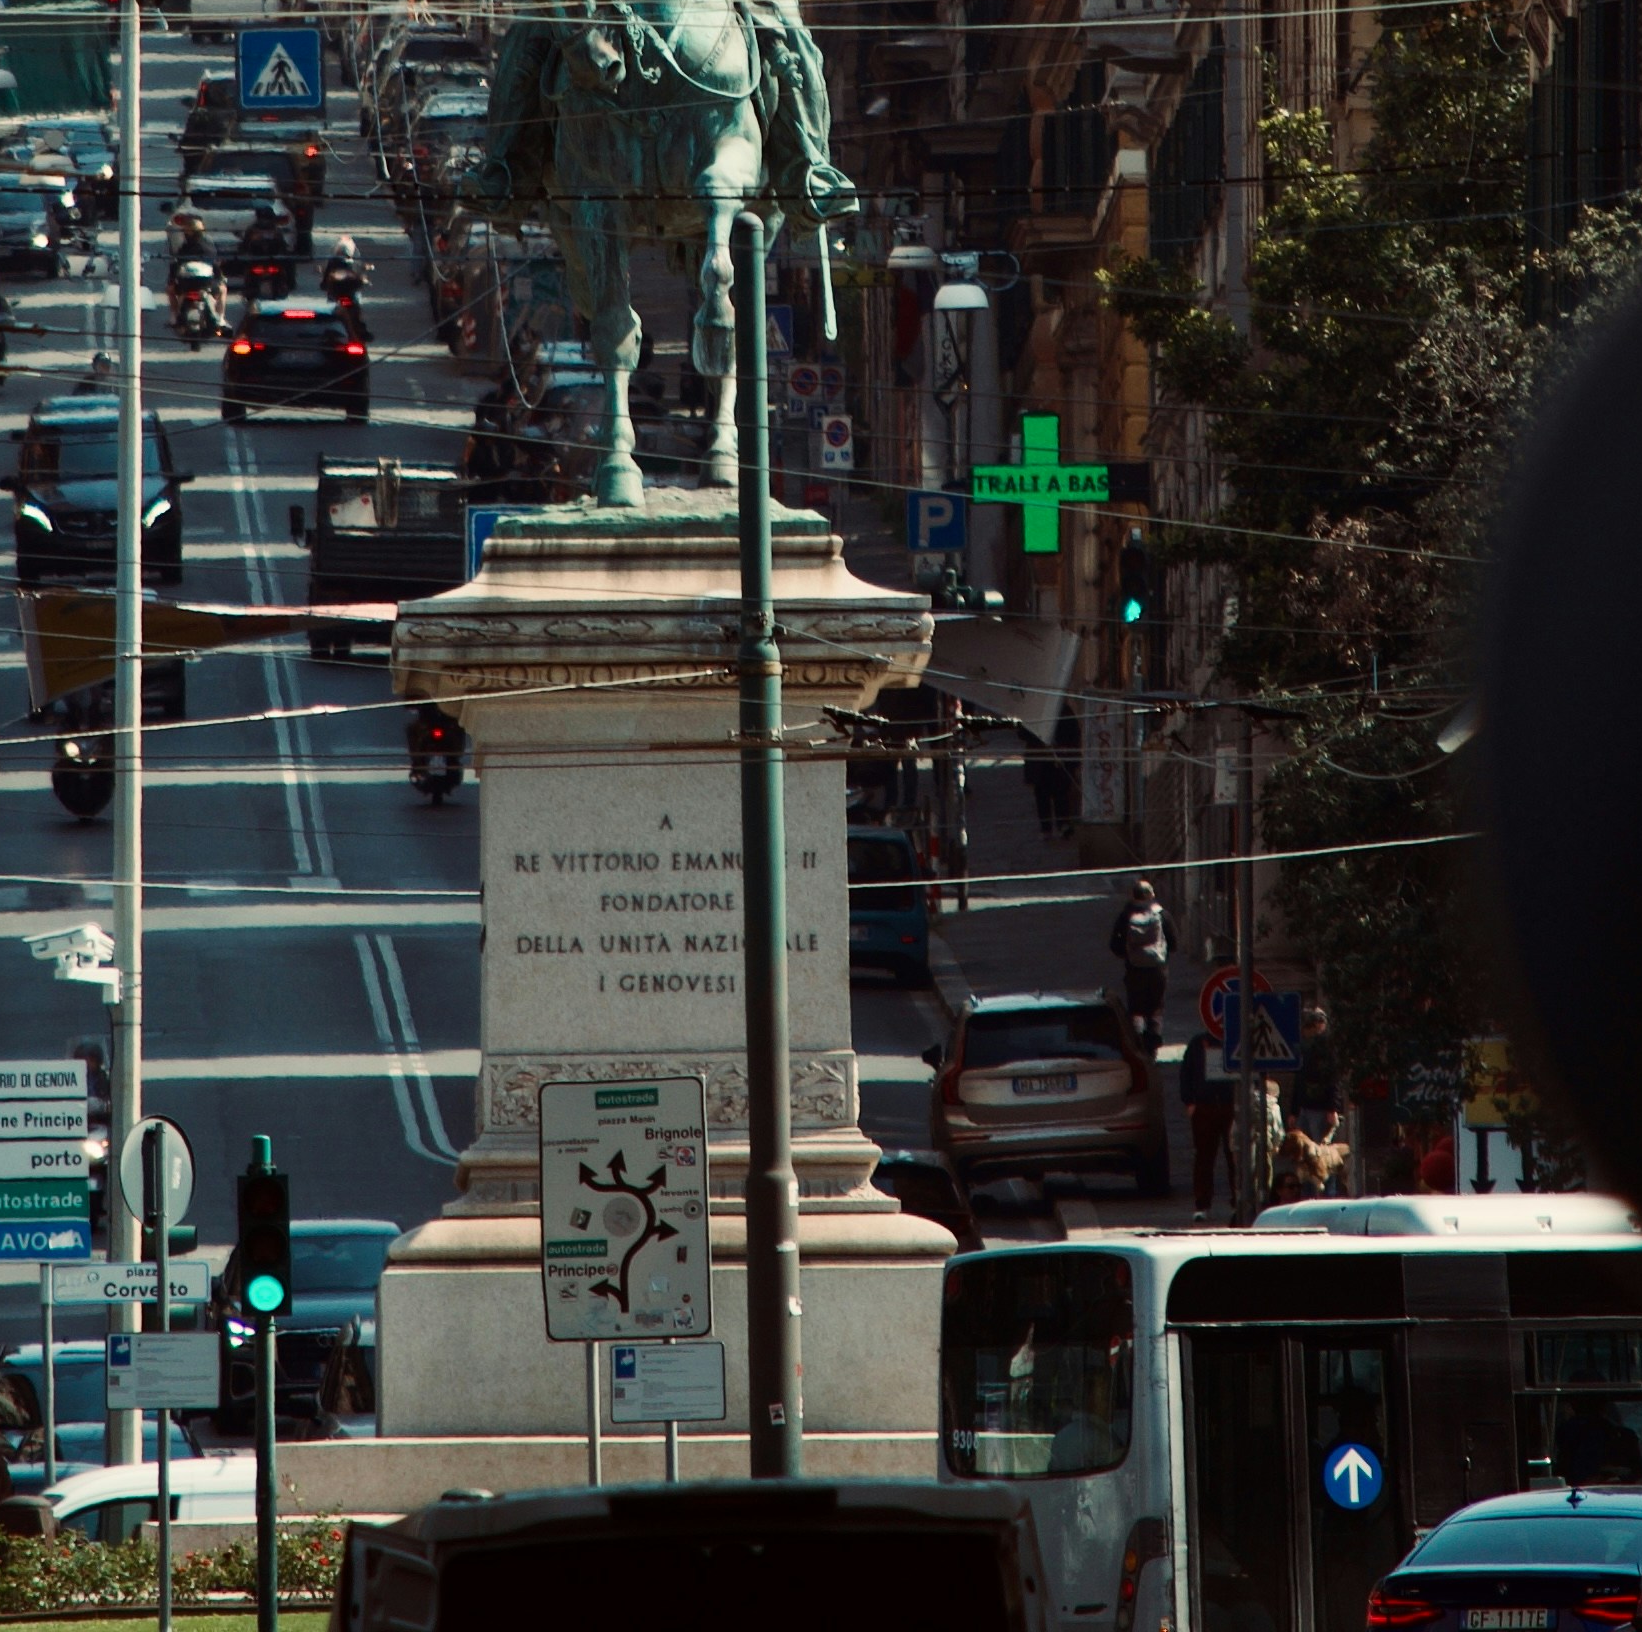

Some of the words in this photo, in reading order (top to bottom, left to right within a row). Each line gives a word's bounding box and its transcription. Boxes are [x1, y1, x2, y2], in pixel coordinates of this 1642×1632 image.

[974, 474, 1039, 494] TRALI
[1046, 475, 1061, 493] A
[659, 814, 673, 830] A
[515, 853, 540, 873] RE
[551, 852, 659, 872] VITTORIO
[803, 851, 817, 869] II
[601, 893, 735, 912] FONDATORE
[517, 935, 583, 954] DELLA
[600, 932, 670, 953] UNITÀ
[599, 975, 605, 993] I
[619, 974, 736, 993] GENOVESI
[21, 1073, 32, 1088] DI
[35, 1072, 78, 1088] GENOVA
[597, 1092, 656, 1106] autostrade
[24, 1112, 83, 1131] Principe
[598, 1116, 626, 1126] piazza
[630, 1114, 656, 1124] Manin
[645, 1126, 703, 1142] Brignole
[31, 1150, 82, 1169] porto
[661, 1188, 699, 1198] levante
[548, 1242, 607, 1256] autostrade
[548, 1262, 606, 1279] Principe
[103, 1281, 188, 1298] Corveto
